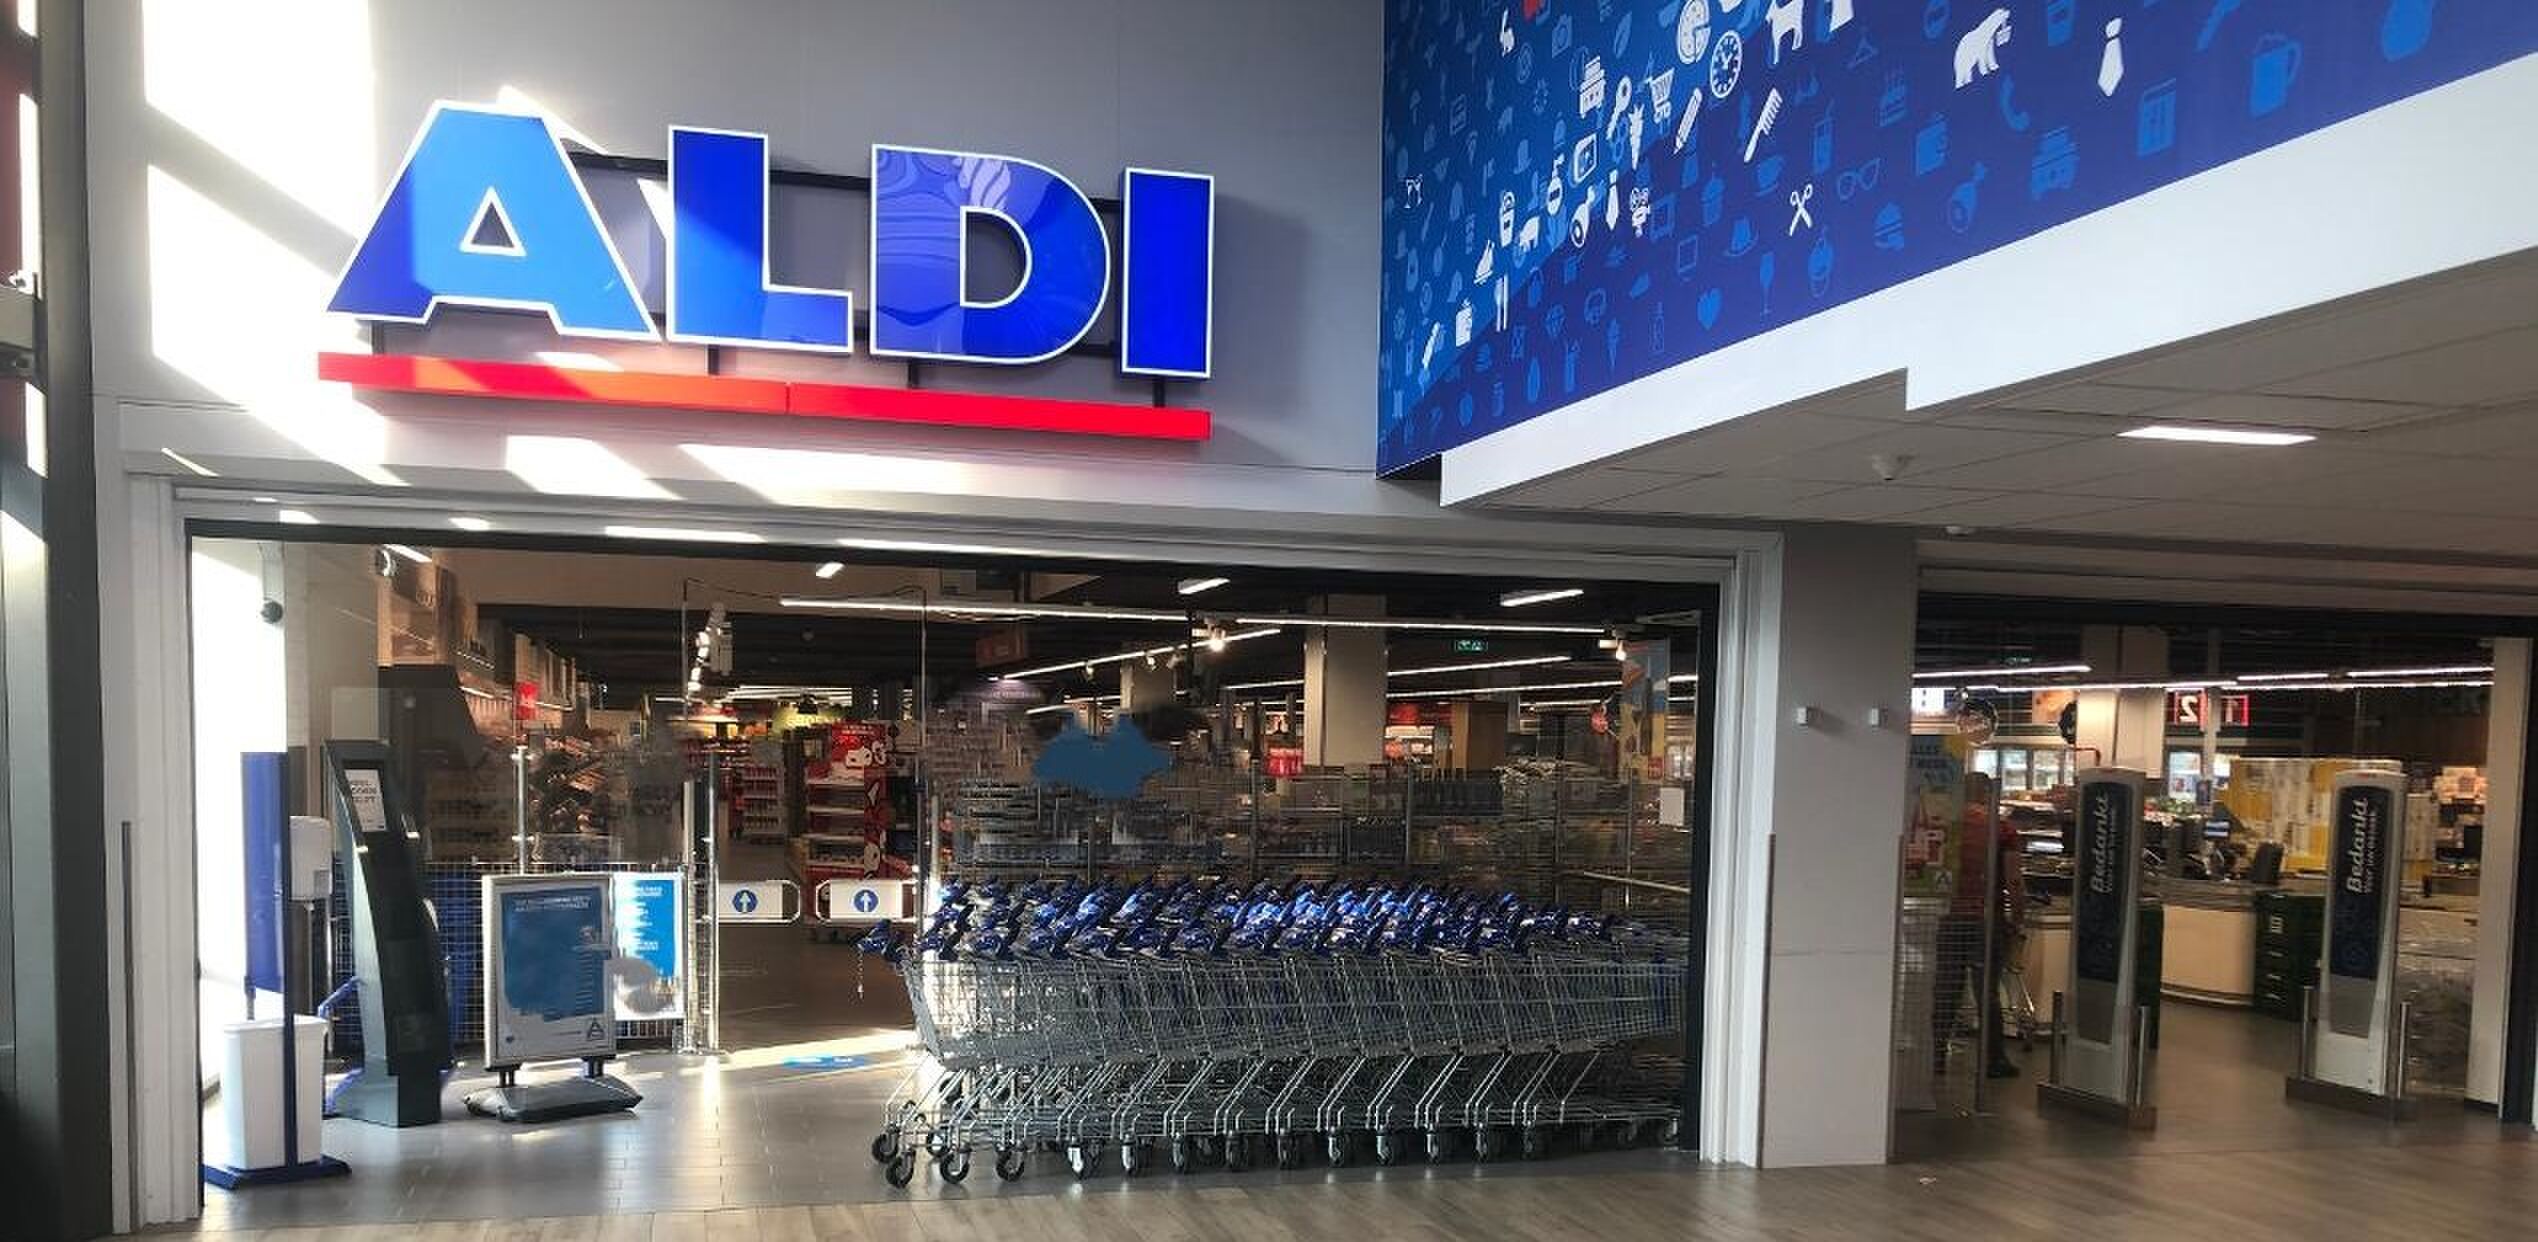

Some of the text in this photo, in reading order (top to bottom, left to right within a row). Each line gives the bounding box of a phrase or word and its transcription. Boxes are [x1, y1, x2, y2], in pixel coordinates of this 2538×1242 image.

[326, 99, 1214, 379] ALDI
[2090, 792, 2109, 892] Bedankt
[2346, 798, 2368, 893] Bedankt
